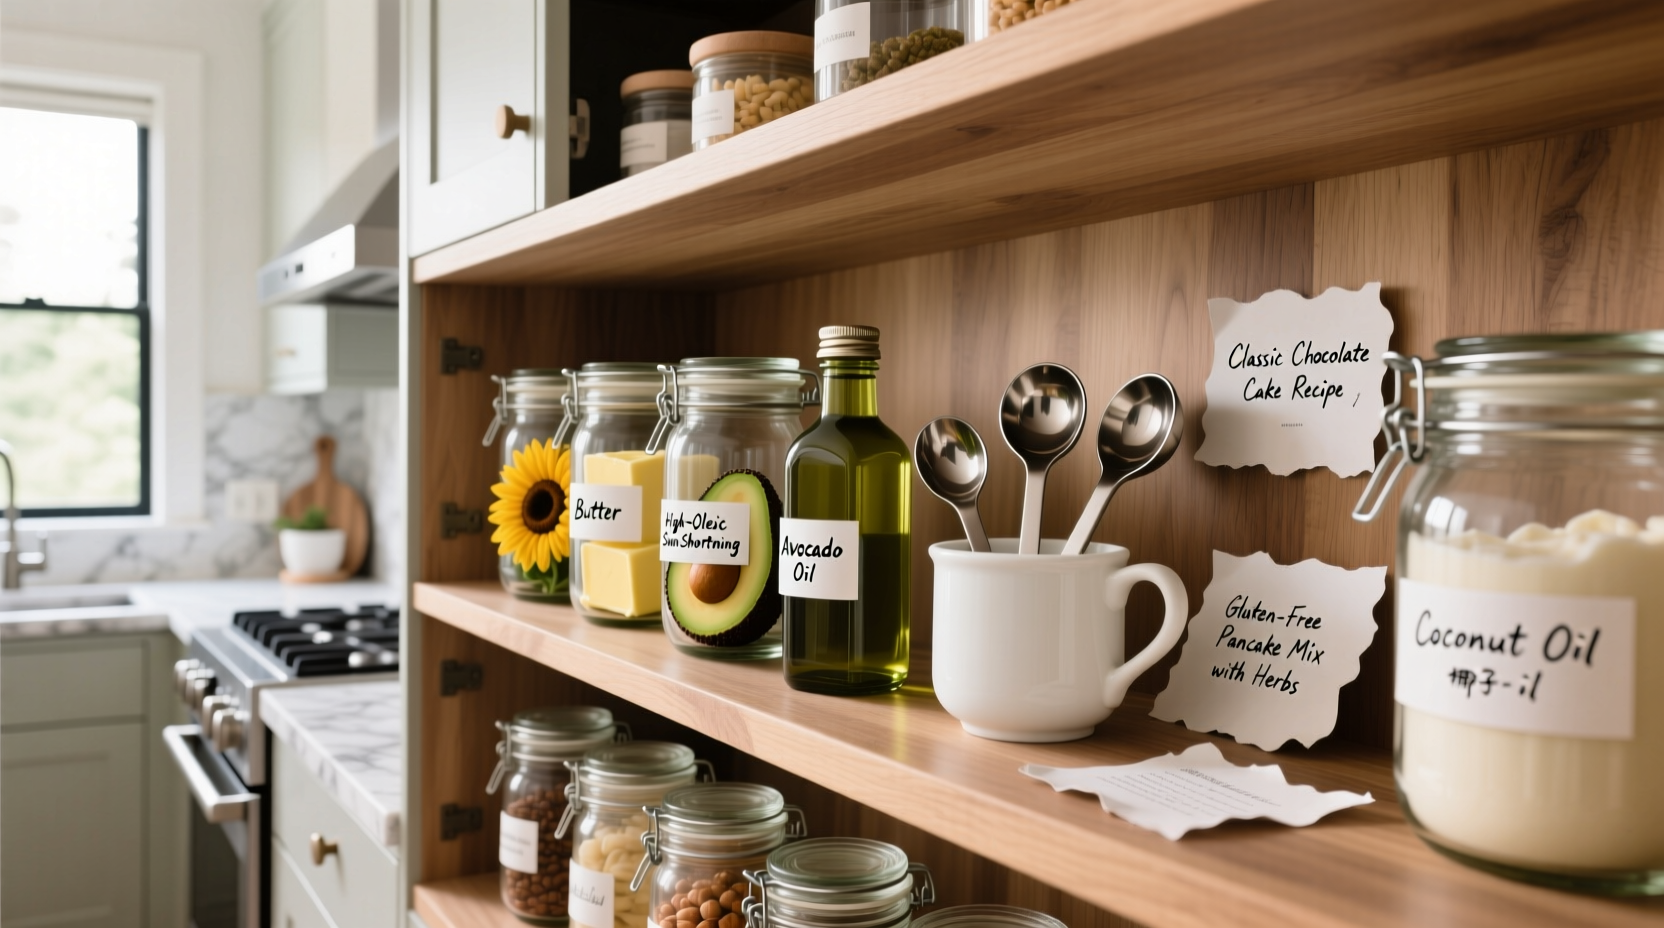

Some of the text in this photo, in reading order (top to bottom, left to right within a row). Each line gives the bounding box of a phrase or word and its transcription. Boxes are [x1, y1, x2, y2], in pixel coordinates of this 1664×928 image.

[1228, 340, 1370, 369] Classic Chocolate
[1243, 374, 1344, 409] Cake Recipe
[574, 498, 622, 521] Butter
[680, 532, 741, 558] Shortning
[781, 535, 843, 558] Avocado
[793, 562, 816, 583] Oil
[1225, 594, 1322, 629] Gluten-Free
[1215, 624, 1325, 665] Pancake Mix
[1415, 609, 1602, 666] Coconut Oil
[1211, 661, 1300, 695] with Herbs
